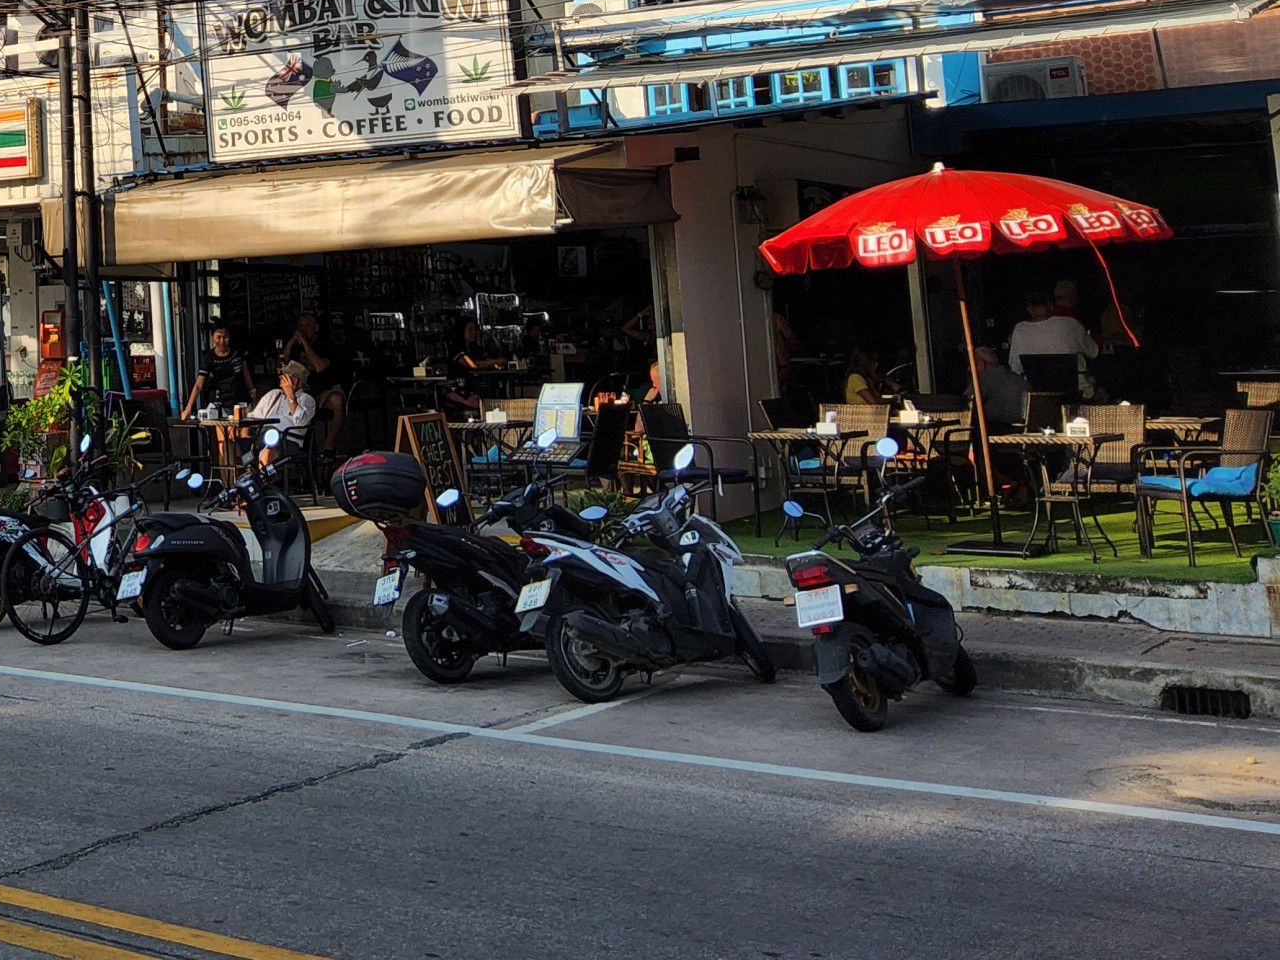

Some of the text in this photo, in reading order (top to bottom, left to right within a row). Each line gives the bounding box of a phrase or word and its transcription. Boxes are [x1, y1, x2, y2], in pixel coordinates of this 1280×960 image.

[310, 21, 384, 56] BAR
[219, 105, 503, 149] SPORTS COFFEE FOOD
[229, 111, 302, 128] 095-3614064
[1005, 215, 1056, 235] LEO
[864, 233, 903, 253] LEO
[929, 226, 979, 245] LEO
[421, 441, 446, 461] CHEF
